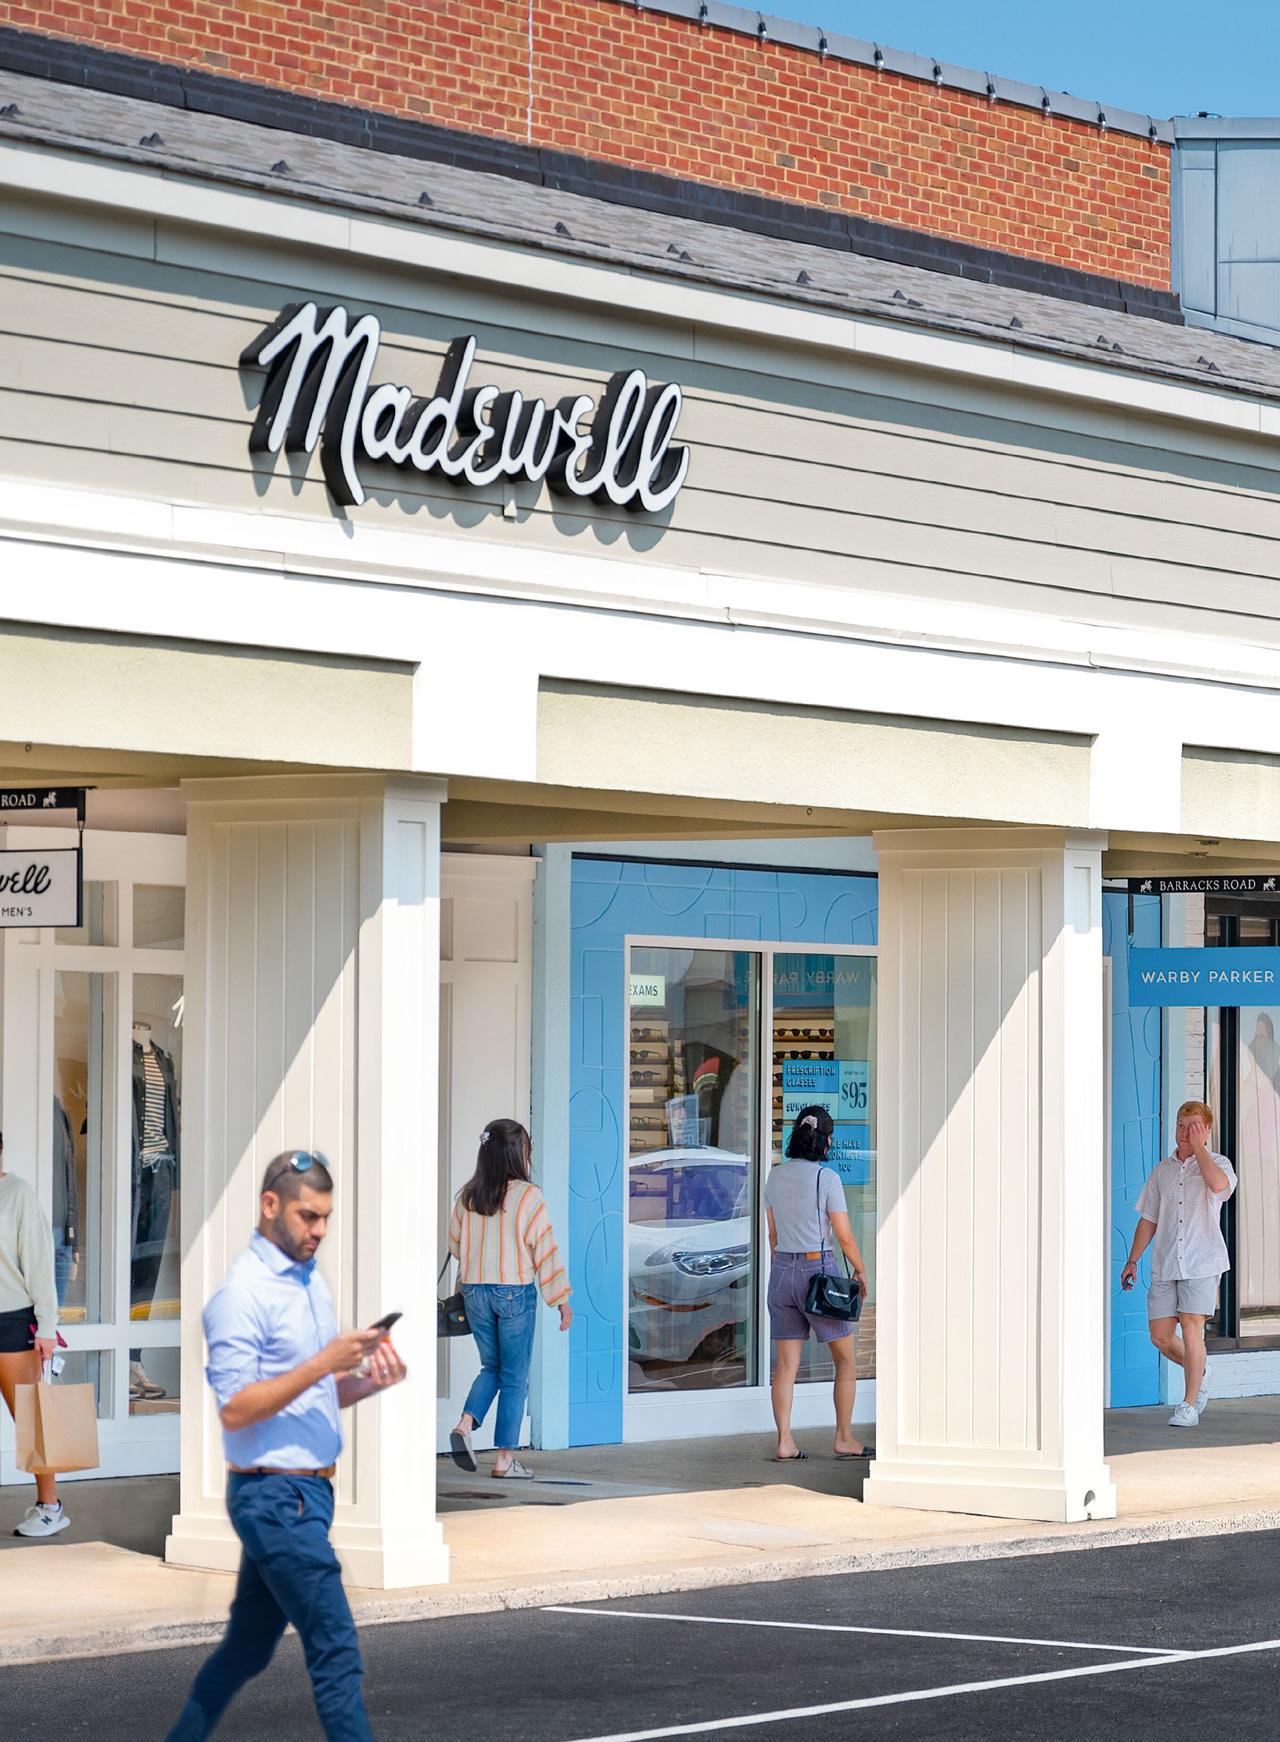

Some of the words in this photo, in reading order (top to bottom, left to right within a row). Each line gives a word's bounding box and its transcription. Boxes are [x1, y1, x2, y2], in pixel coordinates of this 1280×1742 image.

[240, 302, 690, 513] Madewell
[1, 794, 37, 807] ROAD
[1159, 879, 1220, 892] BARRACKS
[1223, 878, 1257, 891] ROAD
[1, 906, 33, 918] MEN'S
[1140, 970, 1201, 984] WARBY
[1209, 970, 1275, 984] PARKER
[786, 1065, 836, 1077] PRESCRIPTION
[786, 1077, 817, 1088] GLASSES
[841, 1081, 867, 1109] $95
